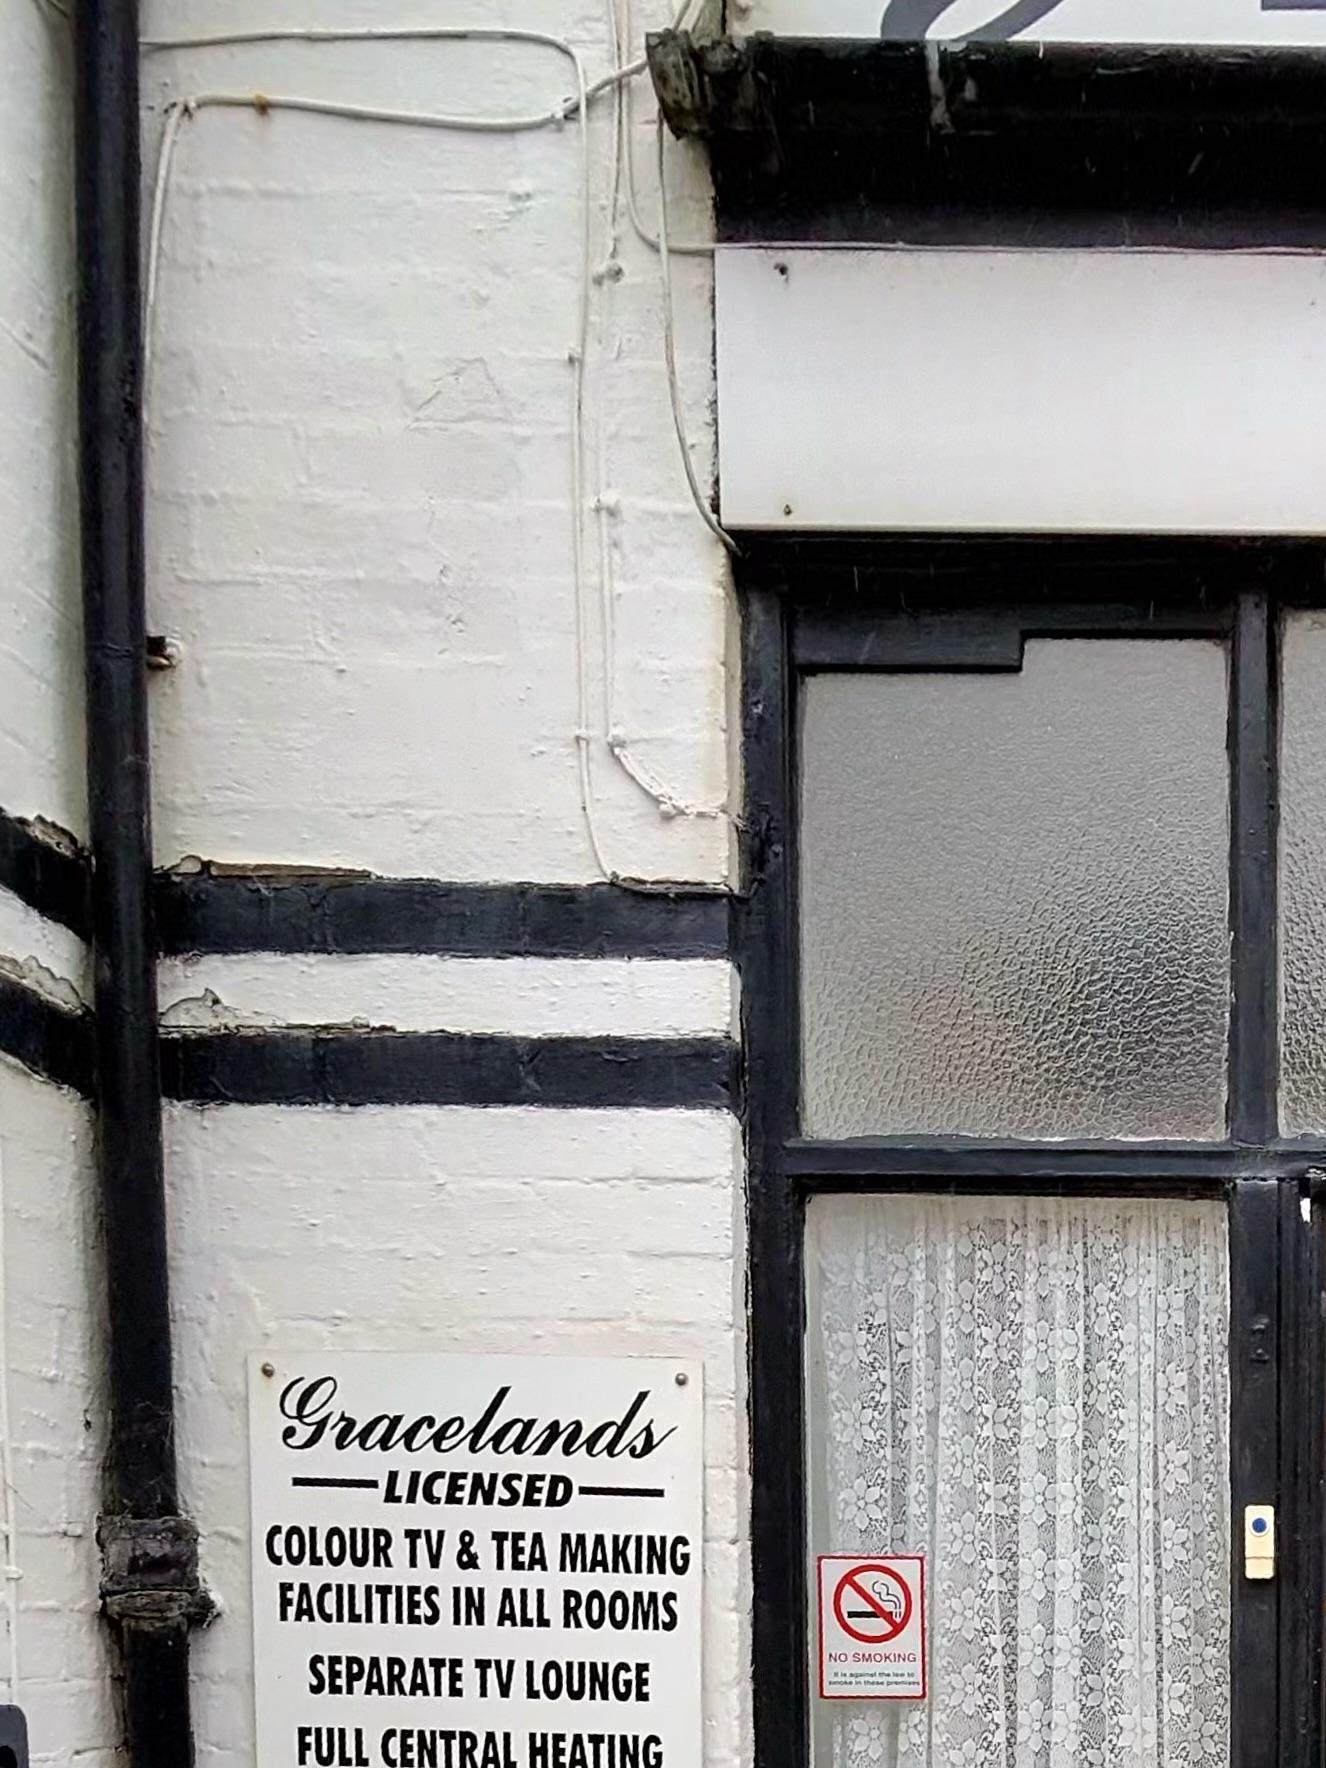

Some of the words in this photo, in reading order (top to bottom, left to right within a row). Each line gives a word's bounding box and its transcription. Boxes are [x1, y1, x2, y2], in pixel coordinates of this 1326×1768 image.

[279, 1376, 677, 1459] Gracelands
[383, 1470, 574, 1508] LICENSED
[265, 1524, 393, 1568] COLOUR
[404, 1528, 446, 1569] TV
[456, 1529, 481, 1571] &
[491, 1530, 548, 1572] TEA
[559, 1532, 690, 1576] MAKING
[279, 1582, 440, 1626] FACILITIES
[452, 1586, 485, 1627] IN
[496, 1587, 551, 1628] ALL
[562, 1589, 678, 1632] ROOMS
[308, 1654, 464, 1698] SEPARATE
[474, 1658, 516, 1699] TV
[525, 1659, 650, 1702] LOUNGE
[828, 1652, 849, 1663] NO
[853, 1652, 917, 1663] SMOKING
[297, 1726, 370, 1768] FULL
